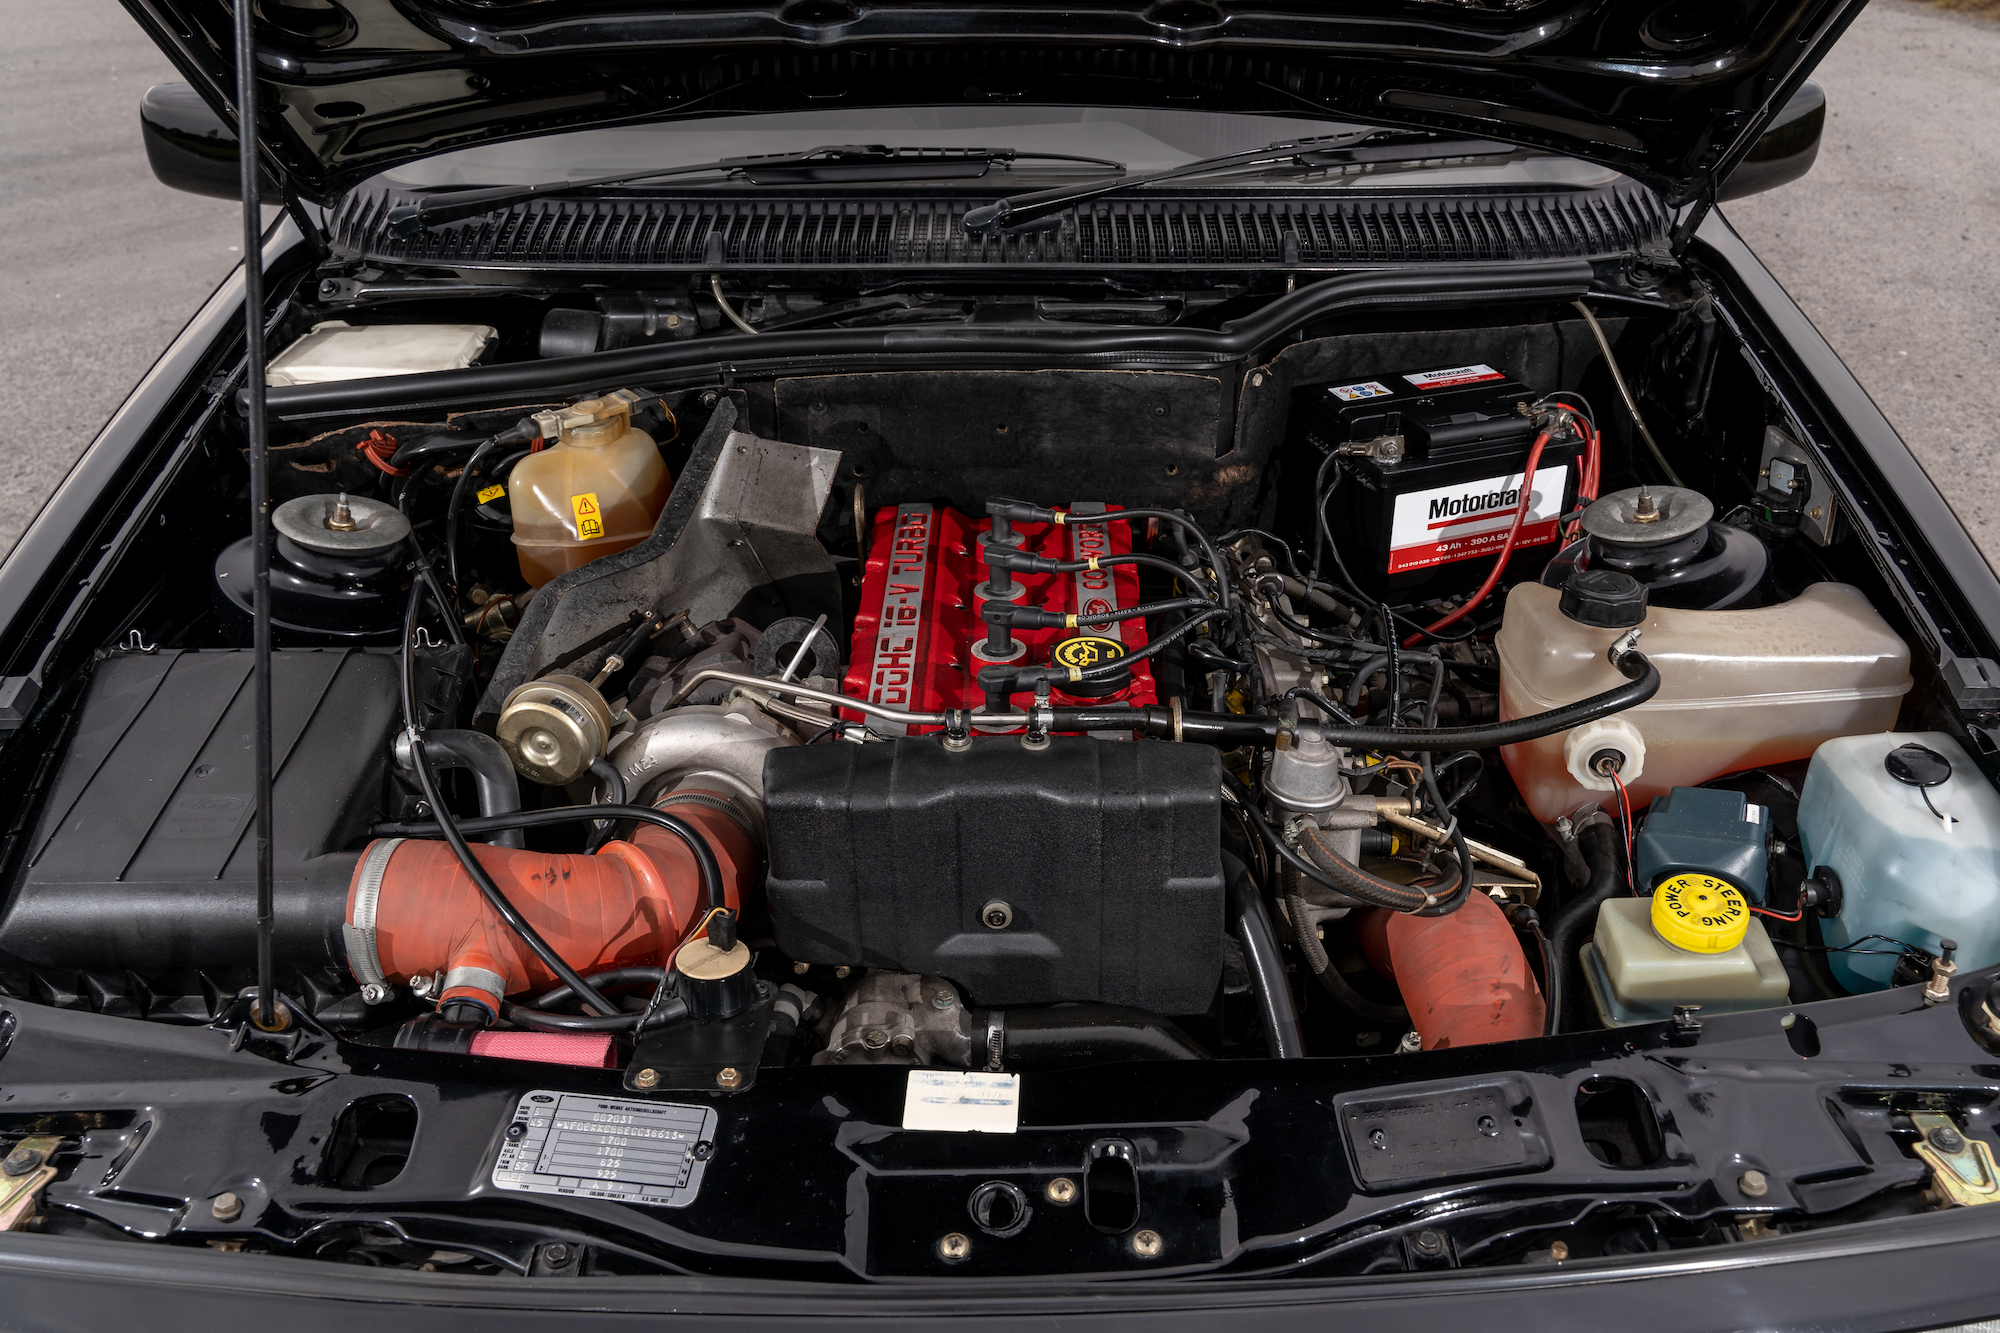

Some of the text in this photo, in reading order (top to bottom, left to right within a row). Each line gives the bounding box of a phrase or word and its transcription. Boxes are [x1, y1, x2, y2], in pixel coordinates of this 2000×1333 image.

[1428, 484, 1530, 520] Motorcra
[1078, 511, 1109, 590] COWORT
[1436, 544, 1448, 552] 43
[1449, 542, 1462, 550] Ah
[1470, 536, 1489, 546] 390
[1496, 532, 1511, 541] SA
[872, 513, 928, 704] DOHC 16-V TURBO
[1665, 879, 1742, 926] POWER STEERING
[596, 1146, 624, 1157] 1700
[600, 1136, 627, 1146] 1700
[597, 1169, 618, 1179] 925
